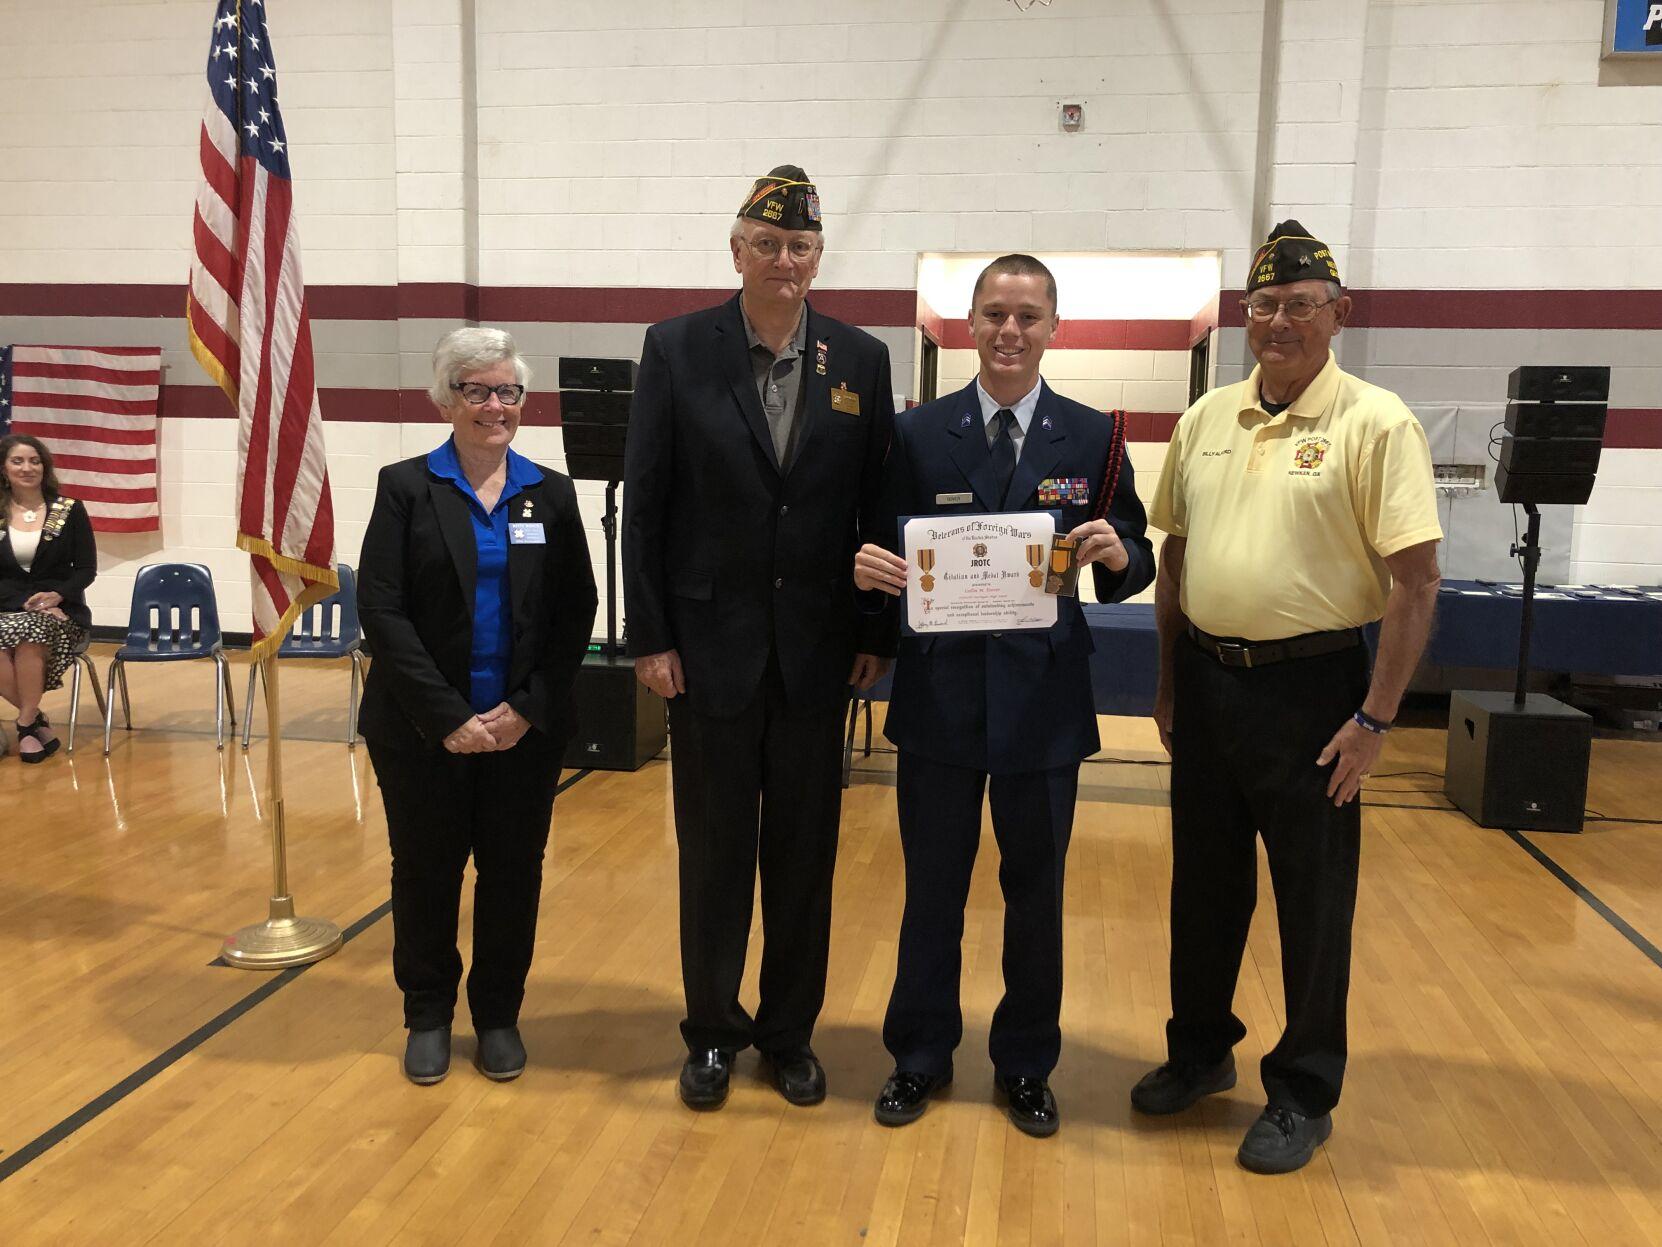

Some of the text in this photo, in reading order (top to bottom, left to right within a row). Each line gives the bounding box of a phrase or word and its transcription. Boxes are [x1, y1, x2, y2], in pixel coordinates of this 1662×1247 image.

[766, 199, 785, 212] VFW
[1260, 263, 1274, 273] VFW
[927, 521, 1032, 540] Veterans of Foreign Wars
[970, 559, 991, 567] JROTC
[943, 571, 968, 581] Citation
[970, 572, 980, 580] and
[1001, 570, 1020, 579] Award
